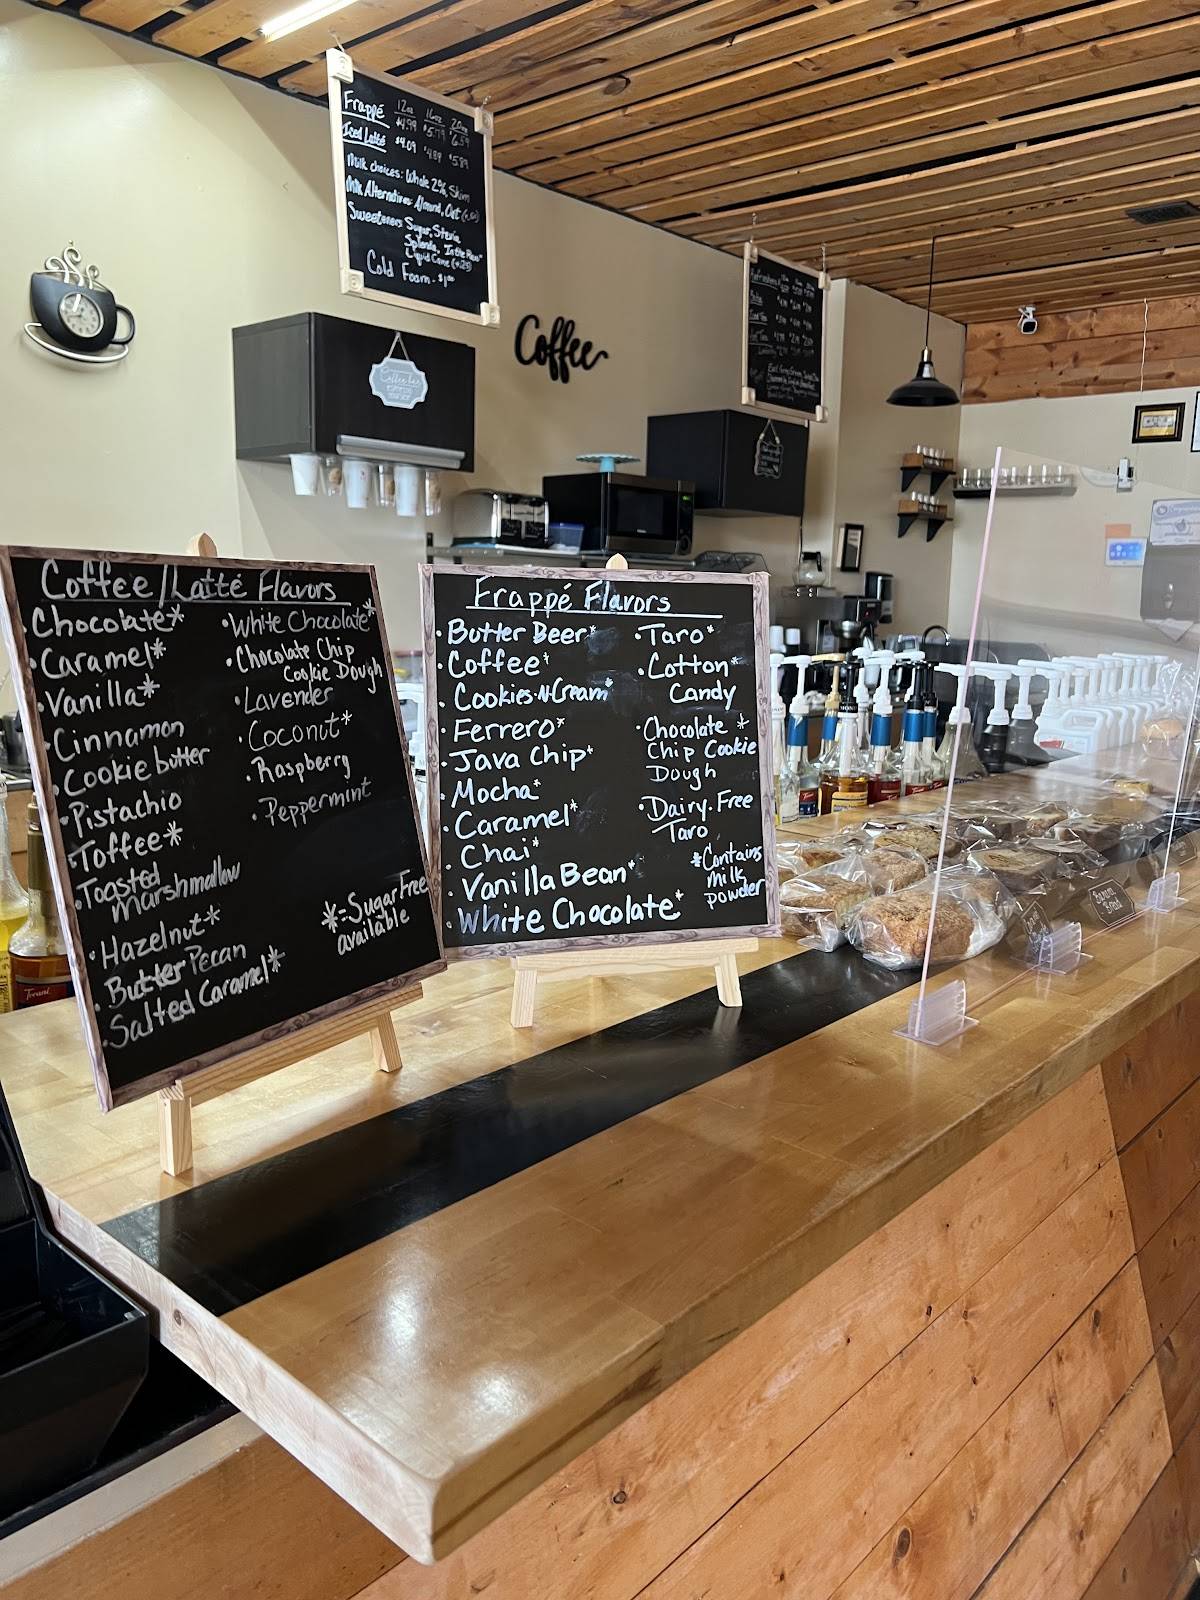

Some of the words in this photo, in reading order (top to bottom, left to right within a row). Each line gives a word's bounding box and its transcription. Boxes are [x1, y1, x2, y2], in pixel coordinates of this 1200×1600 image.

[366, 249, 394, 277] Cold
[514, 314, 609, 384] Coffee
[258, 568, 337, 602] Flavors
[474, 575, 573, 618] Frappé
[584, 580, 671, 613] Flavors
[228, 608, 286, 638] White
[447, 618, 526, 645] Butter
[235, 639, 310, 673] Chocolate
[317, 637, 355, 663] Chip
[284, 662, 332, 682] Cookie
[333, 657, 382, 694] Dough
[244, 680, 334, 715] Lavender
[669, 680, 737, 710] Candy
[53, 721, 185, 762] Cinnamon
[647, 741, 695, 763] Chip
[704, 737, 757, 758] Cookie
[64, 756, 151, 797] Cookie
[153, 745, 210, 775] butter
[251, 752, 350, 783] Raspberry
[449, 748, 520, 773] Java
[645, 762, 717, 791] Dough
[68, 790, 182, 838] Pistachio
[258, 777, 372, 828] Peppermint
[651, 817, 709, 843] Taro
[76, 861, 161, 909] Toasted
[462, 863, 557, 901] Vanilla
[703, 878, 766, 910] powder
[337, 907, 410, 955] available
[457, 902, 545, 934] White
[104, 960, 186, 1009] Butter
[184, 943, 246, 975] Pecan
[109, 988, 196, 1049] Salted
